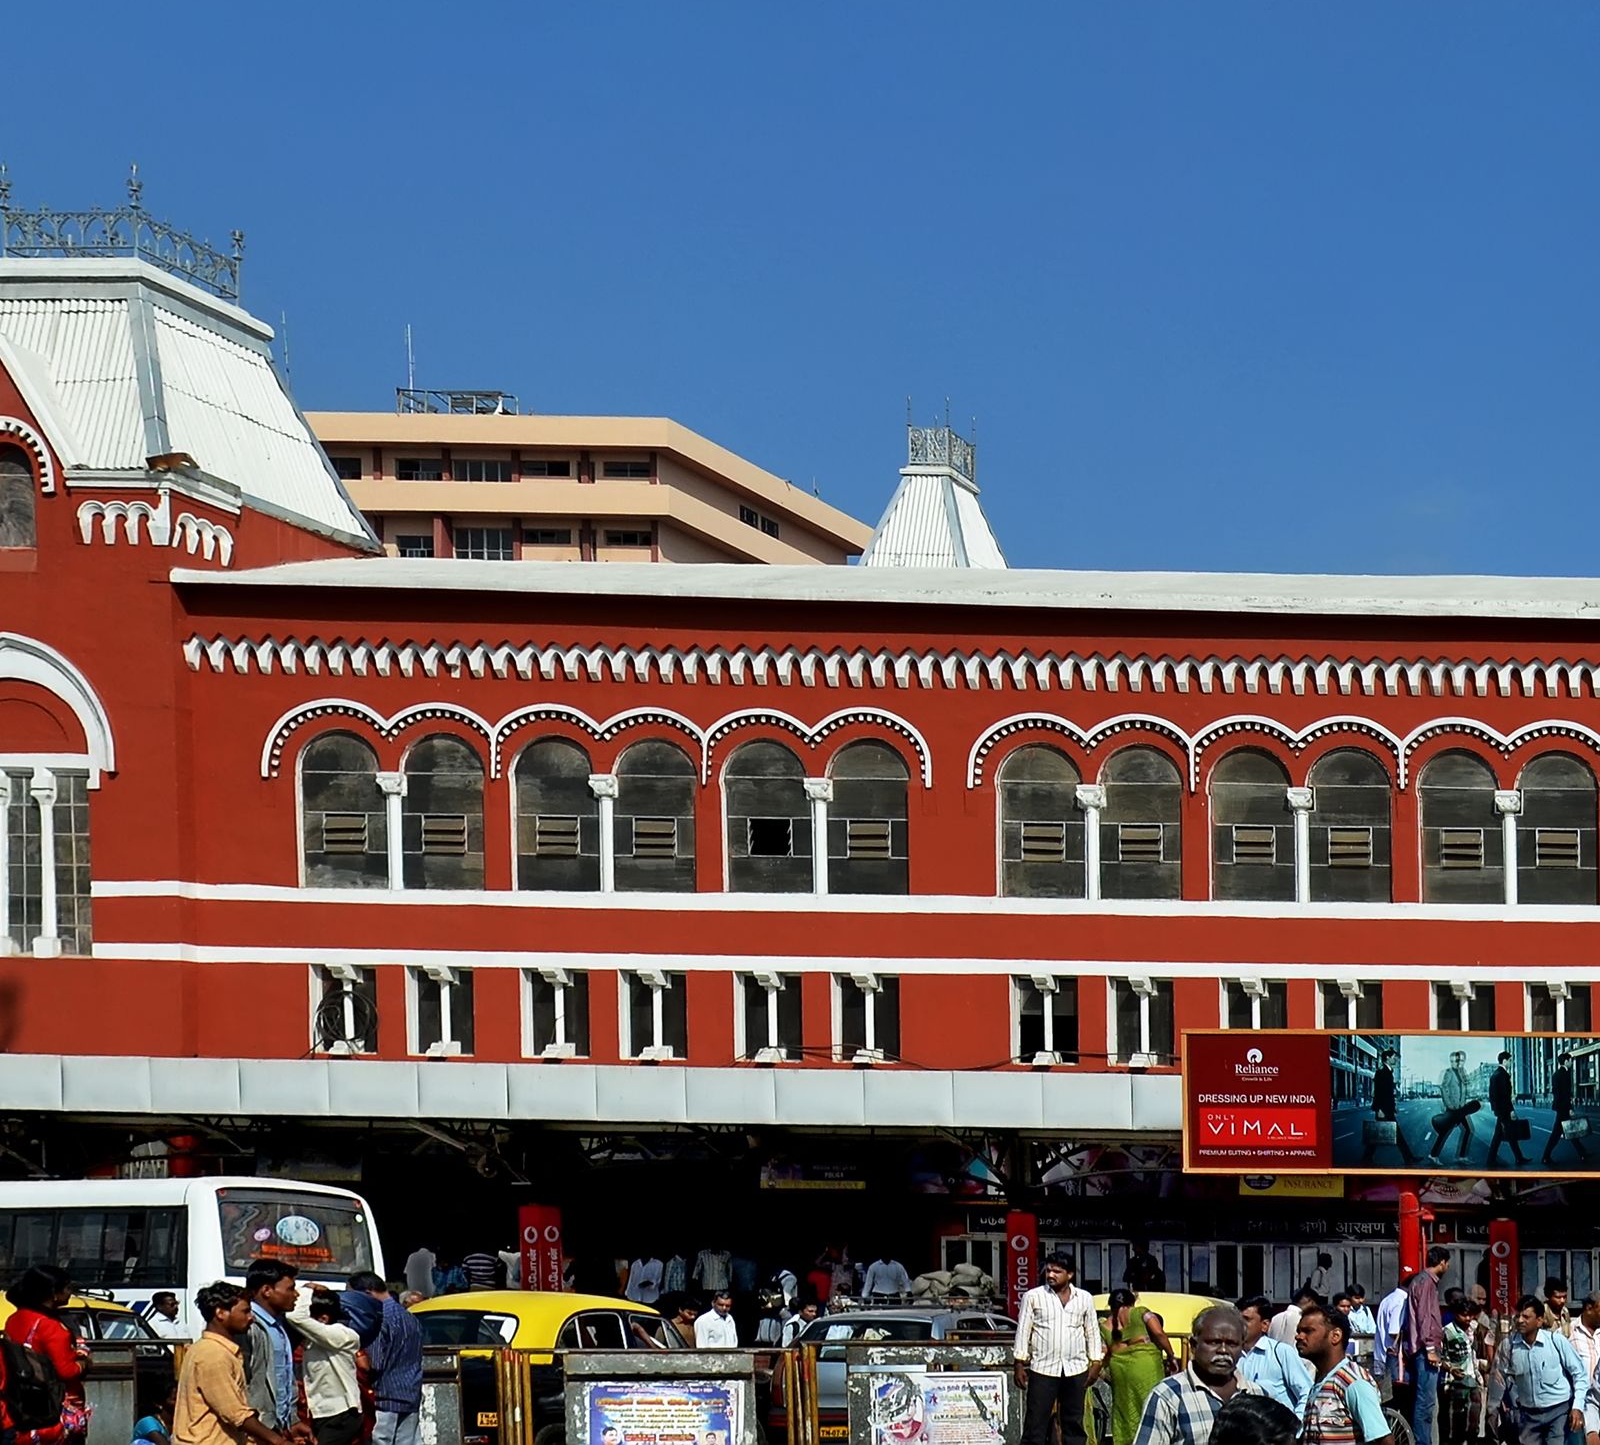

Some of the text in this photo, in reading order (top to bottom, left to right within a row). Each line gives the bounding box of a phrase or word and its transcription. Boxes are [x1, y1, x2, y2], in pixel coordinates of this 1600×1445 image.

[1235, 1064, 1279, 1074] Reliance
[1199, 1094, 1315, 1103] DRESSING UP NEW INDIA
[1208, 1120, 1304, 1135] VIMAL
[1284, 1179, 1334, 1190] INSURANCE
[1335, 1219, 1385, 1235] आरक्षण
